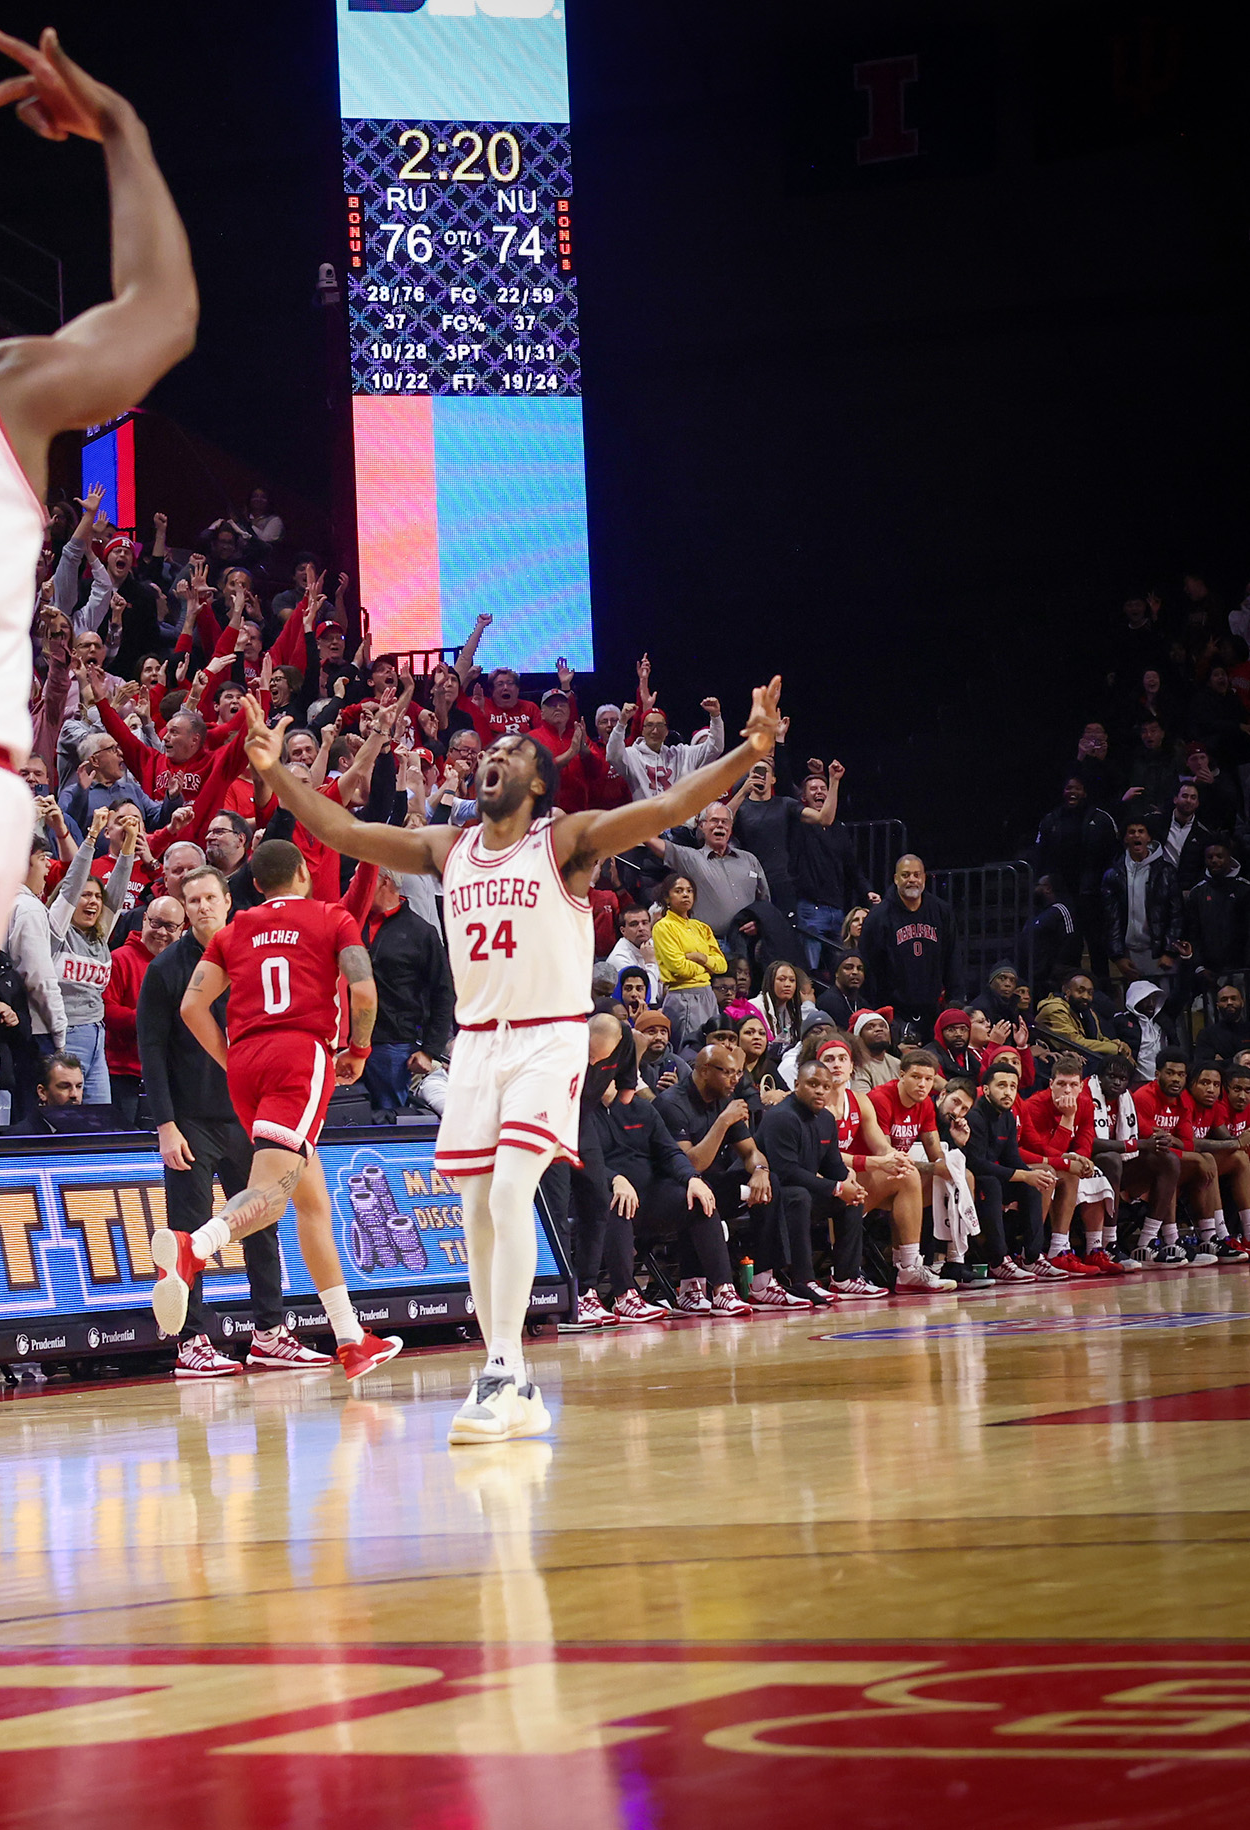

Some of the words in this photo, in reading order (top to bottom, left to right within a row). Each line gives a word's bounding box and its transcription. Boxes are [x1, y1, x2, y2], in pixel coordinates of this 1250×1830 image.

[398, 129, 520, 182] 2:20
[386, 188, 427, 212] RU
[497, 189, 537, 213] NU
[379, 223, 434, 264] 76
[443, 229, 482, 246] OT/1
[492, 225, 545, 265] 74
[367, 286, 425, 303] 28/76
[450, 287, 477, 303] FG
[497, 287, 554, 304] 22/59
[384, 313, 406, 330] 37
[442, 315, 485, 332] FG%
[513, 314, 537, 331] 37
[370, 343, 427, 361] 10/28
[446, 344, 482, 361] 3PT
[504, 344, 555, 361] 11/31
[372, 373, 428, 391] 10/22
[452, 375, 476, 391] FT
[502, 373, 558, 391] 19/24
[450, 877, 541, 919] RUTGERS
[252, 929, 300, 949] WILCHER
[466, 920, 517, 961] 24
[261, 956, 291, 1015] 0
[413, 1205, 464, 1231] DISCO
[531, 1293, 559, 1306] Prudential
[359, 1308, 389, 1321] Prudential
[419, 1302, 448, 1316] Prudential
[297, 1313, 328, 1327] Prudential
[31, 1335, 66, 1351] Prudential
[101, 1328, 135, 1343] Prudential
